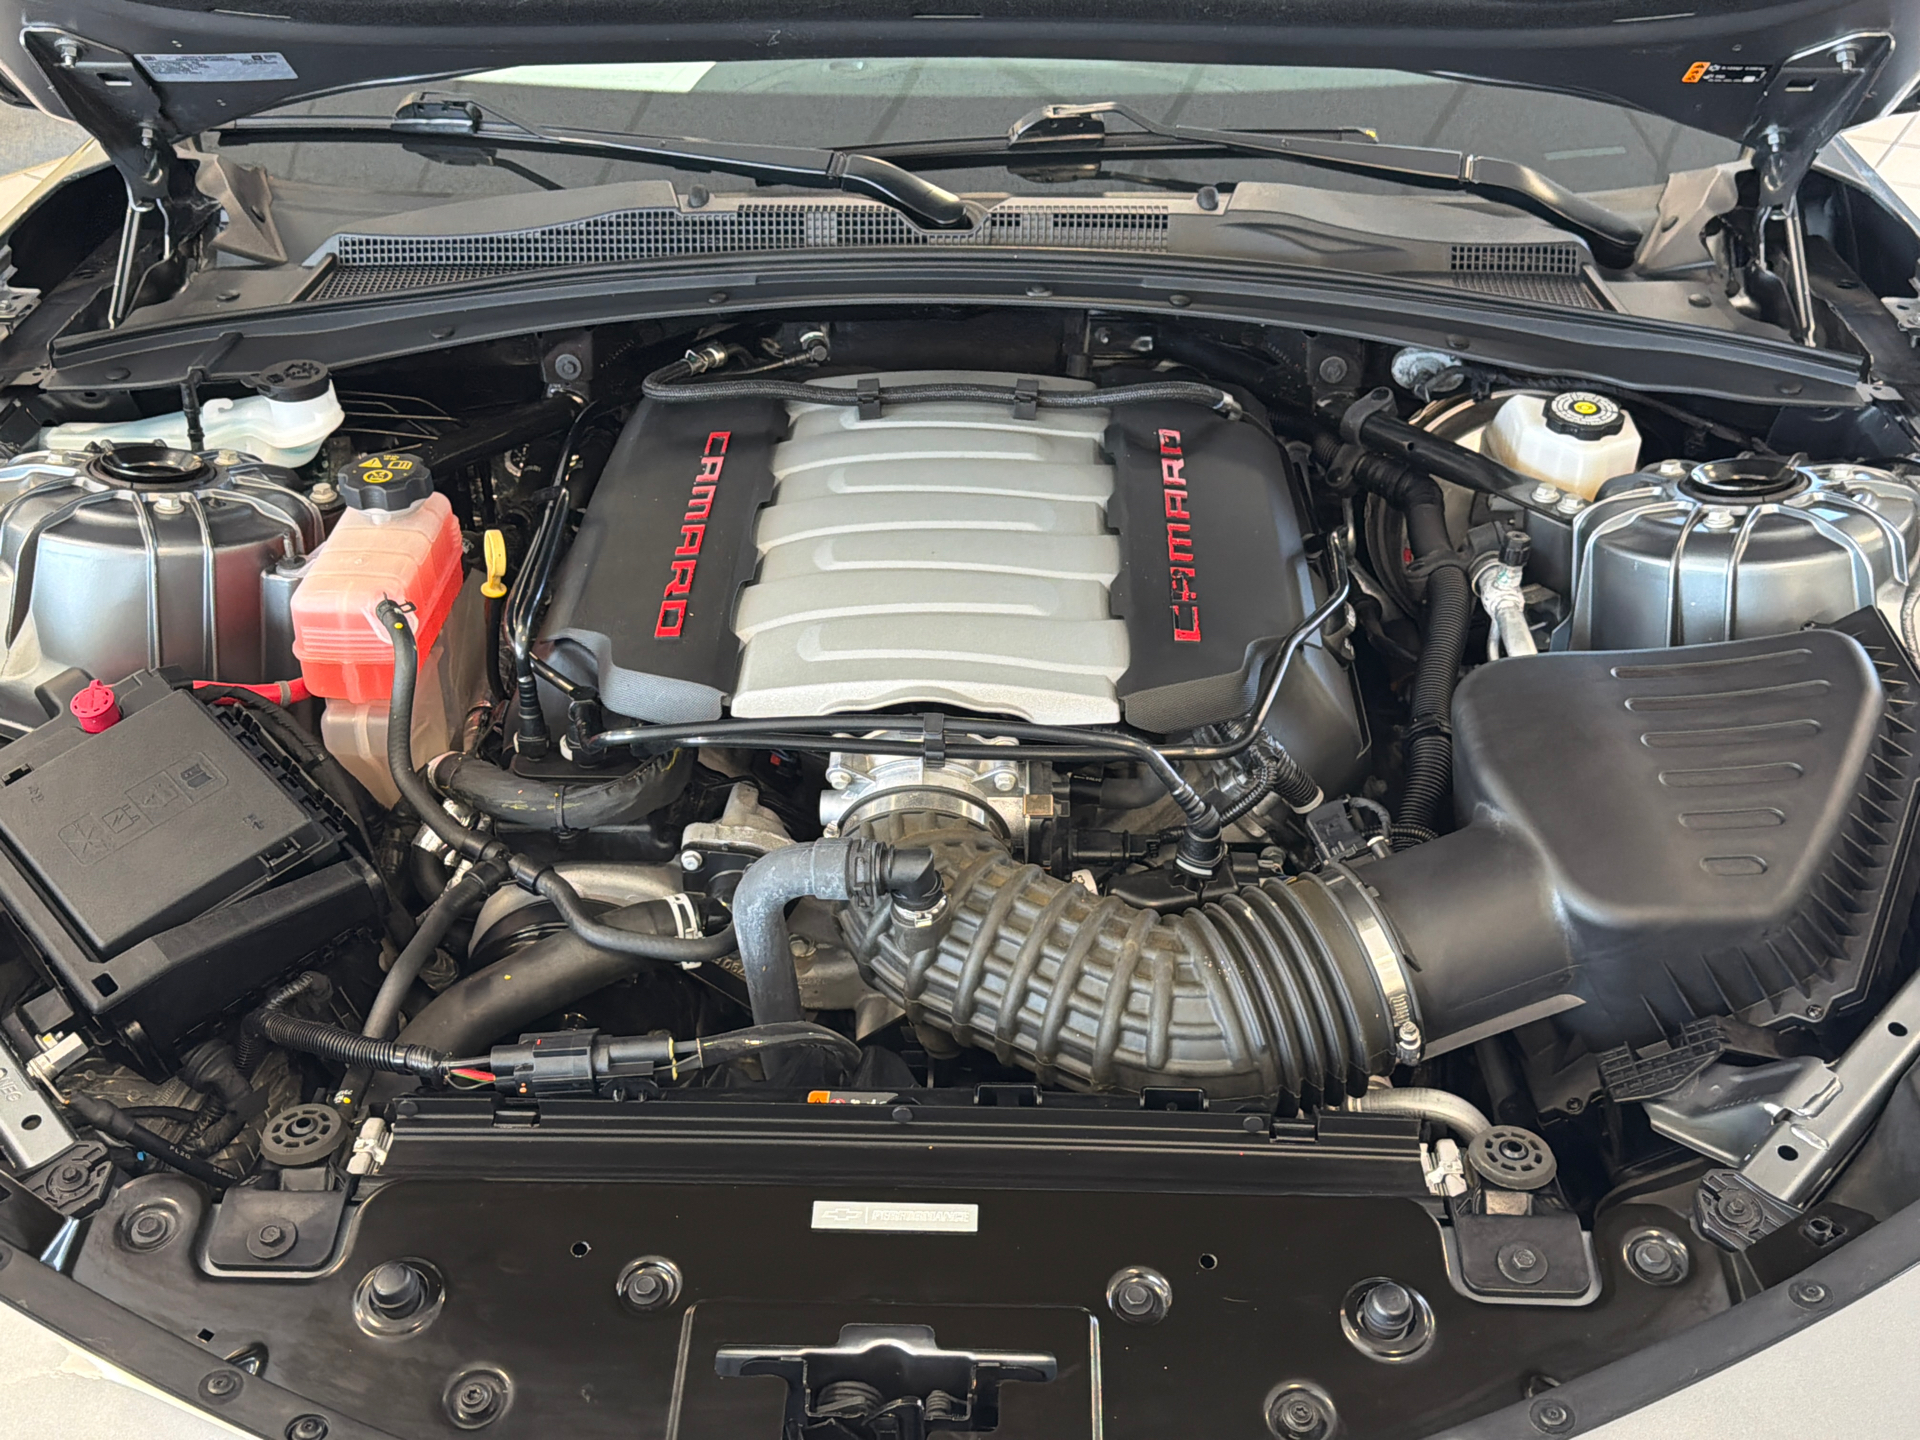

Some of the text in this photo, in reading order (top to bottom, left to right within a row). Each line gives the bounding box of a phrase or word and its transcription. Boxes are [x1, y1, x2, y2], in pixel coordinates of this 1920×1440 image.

[654, 431, 732, 639] CAMARO
[1158, 429, 1201, 641] CAMARO
[871, 1209, 970, 1223] PERFORMANCE
